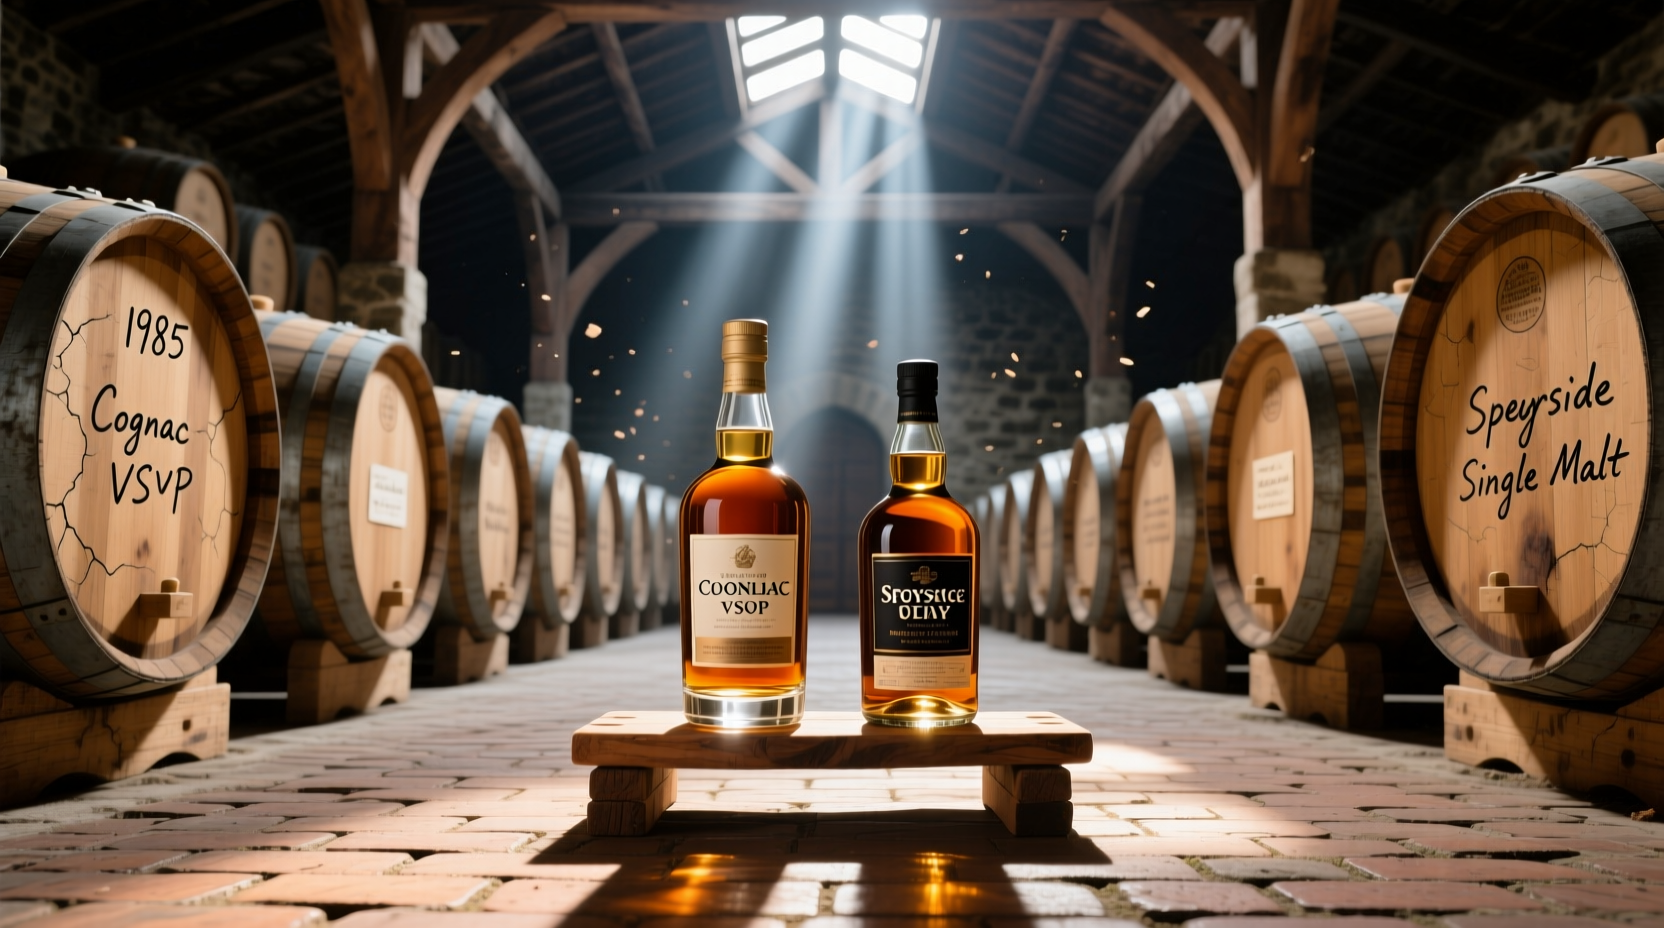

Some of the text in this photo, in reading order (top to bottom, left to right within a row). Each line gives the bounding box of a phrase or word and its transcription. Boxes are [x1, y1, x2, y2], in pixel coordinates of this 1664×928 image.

[124, 306, 190, 360] 1985
[90, 384, 189, 457] Cognac
[1459, 432, 1630, 521] Single Malt
[721, 600, 769, 615] VSOP
